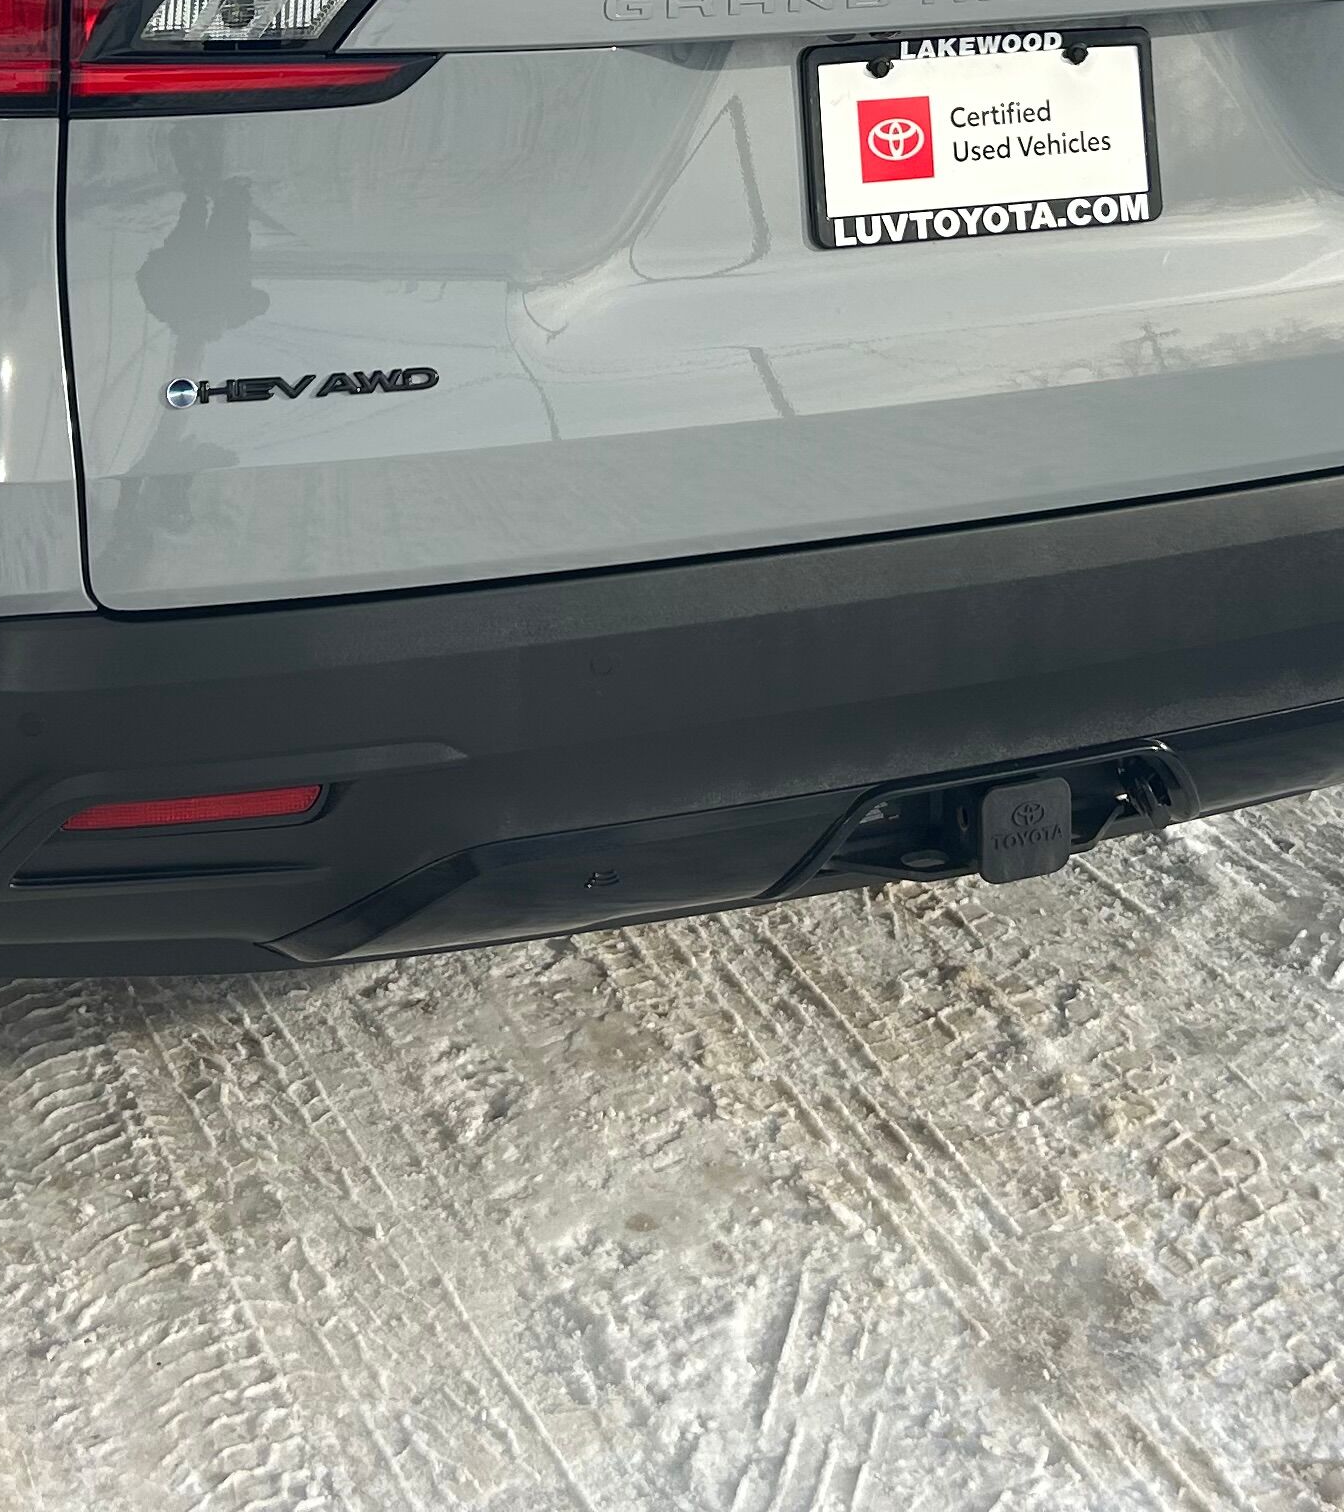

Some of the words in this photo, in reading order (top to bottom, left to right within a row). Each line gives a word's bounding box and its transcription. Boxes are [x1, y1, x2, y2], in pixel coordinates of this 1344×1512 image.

[900, 32, 1063, 61] LAKEWOOD
[950, 100, 1052, 129] Certified
[953, 139, 1012, 162] Used
[1017, 131, 1112, 157] Vehicles
[833, 193, 1150, 247] LUVTOYOTA.COM
[991, 824, 1063, 850] TOYOTA
